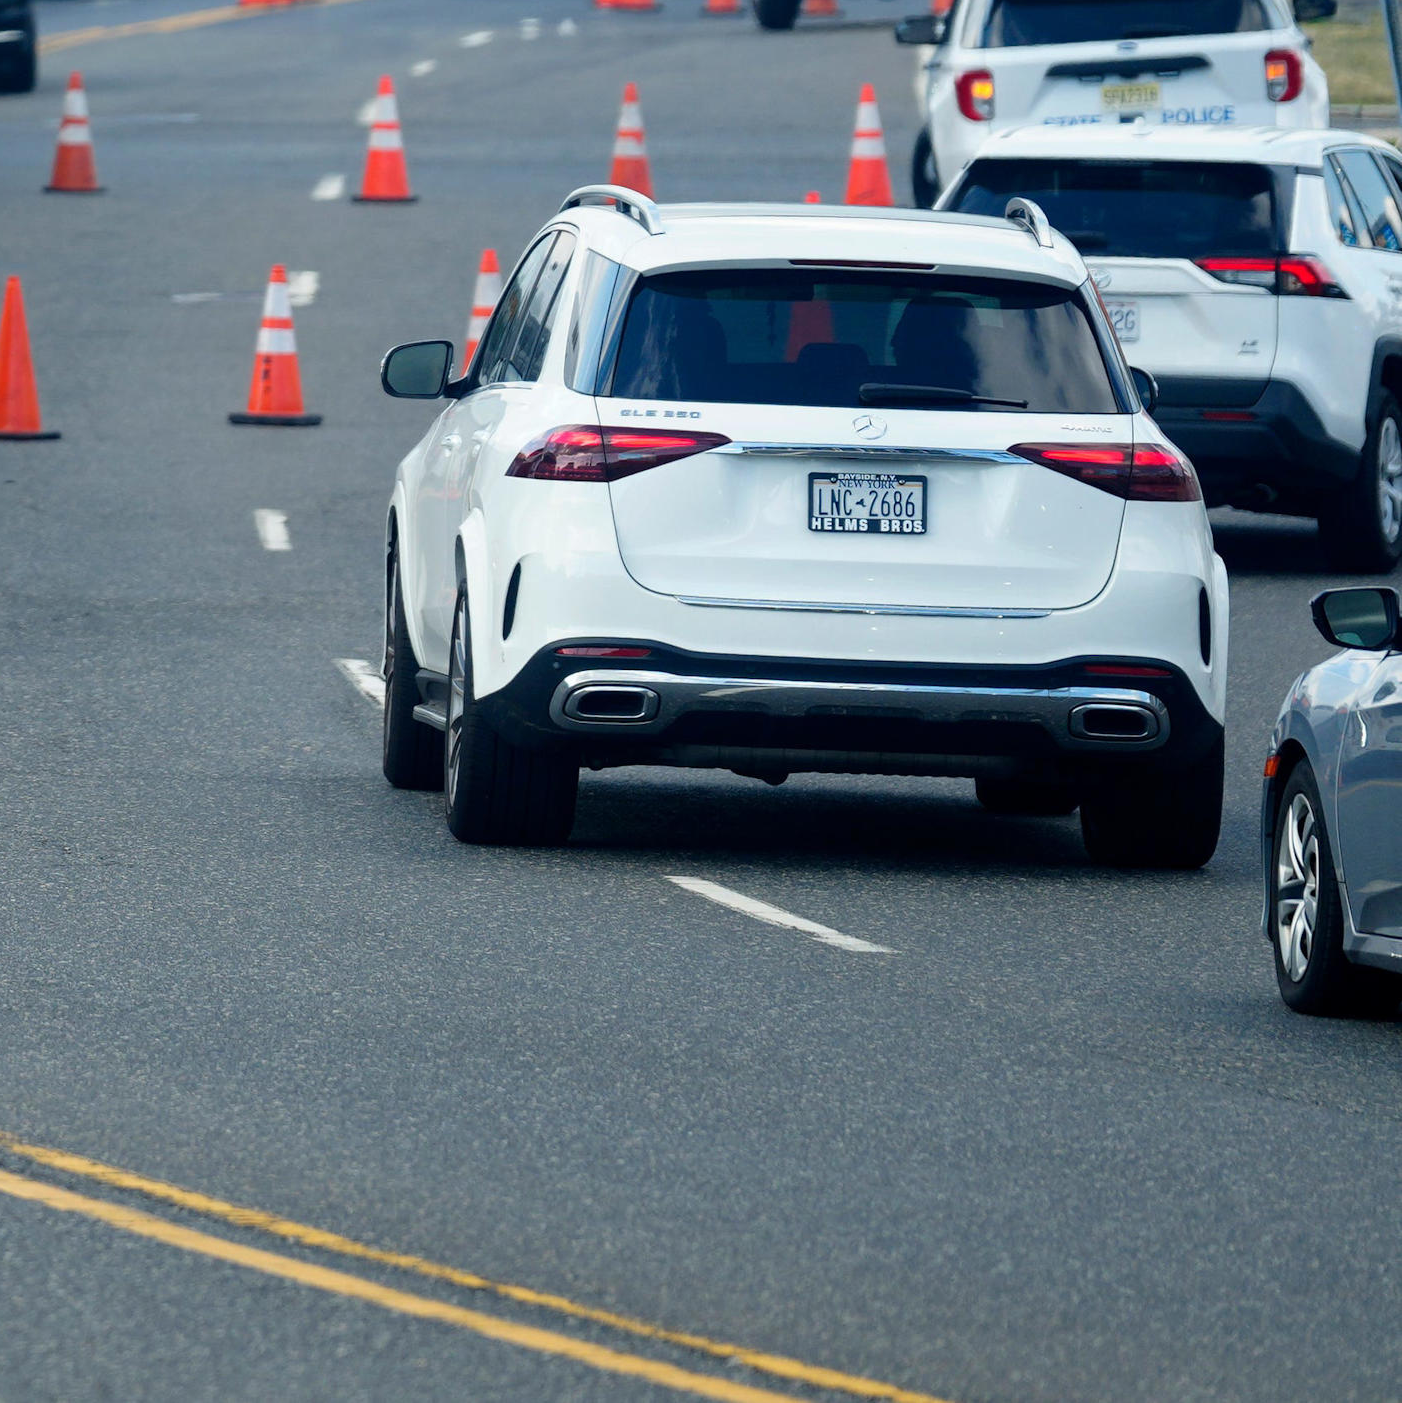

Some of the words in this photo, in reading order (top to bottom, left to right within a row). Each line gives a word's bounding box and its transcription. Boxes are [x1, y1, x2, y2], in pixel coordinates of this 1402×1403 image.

[1162, 104, 1235, 125] POLICE
[838, 480, 864, 488] NEW
[867, 480, 897, 489] YORK
[818, 488, 852, 516] LNC
[869, 490, 915, 518] 2686
[811, 517, 869, 531] HELMS
[880, 519, 925, 533] BROS.
